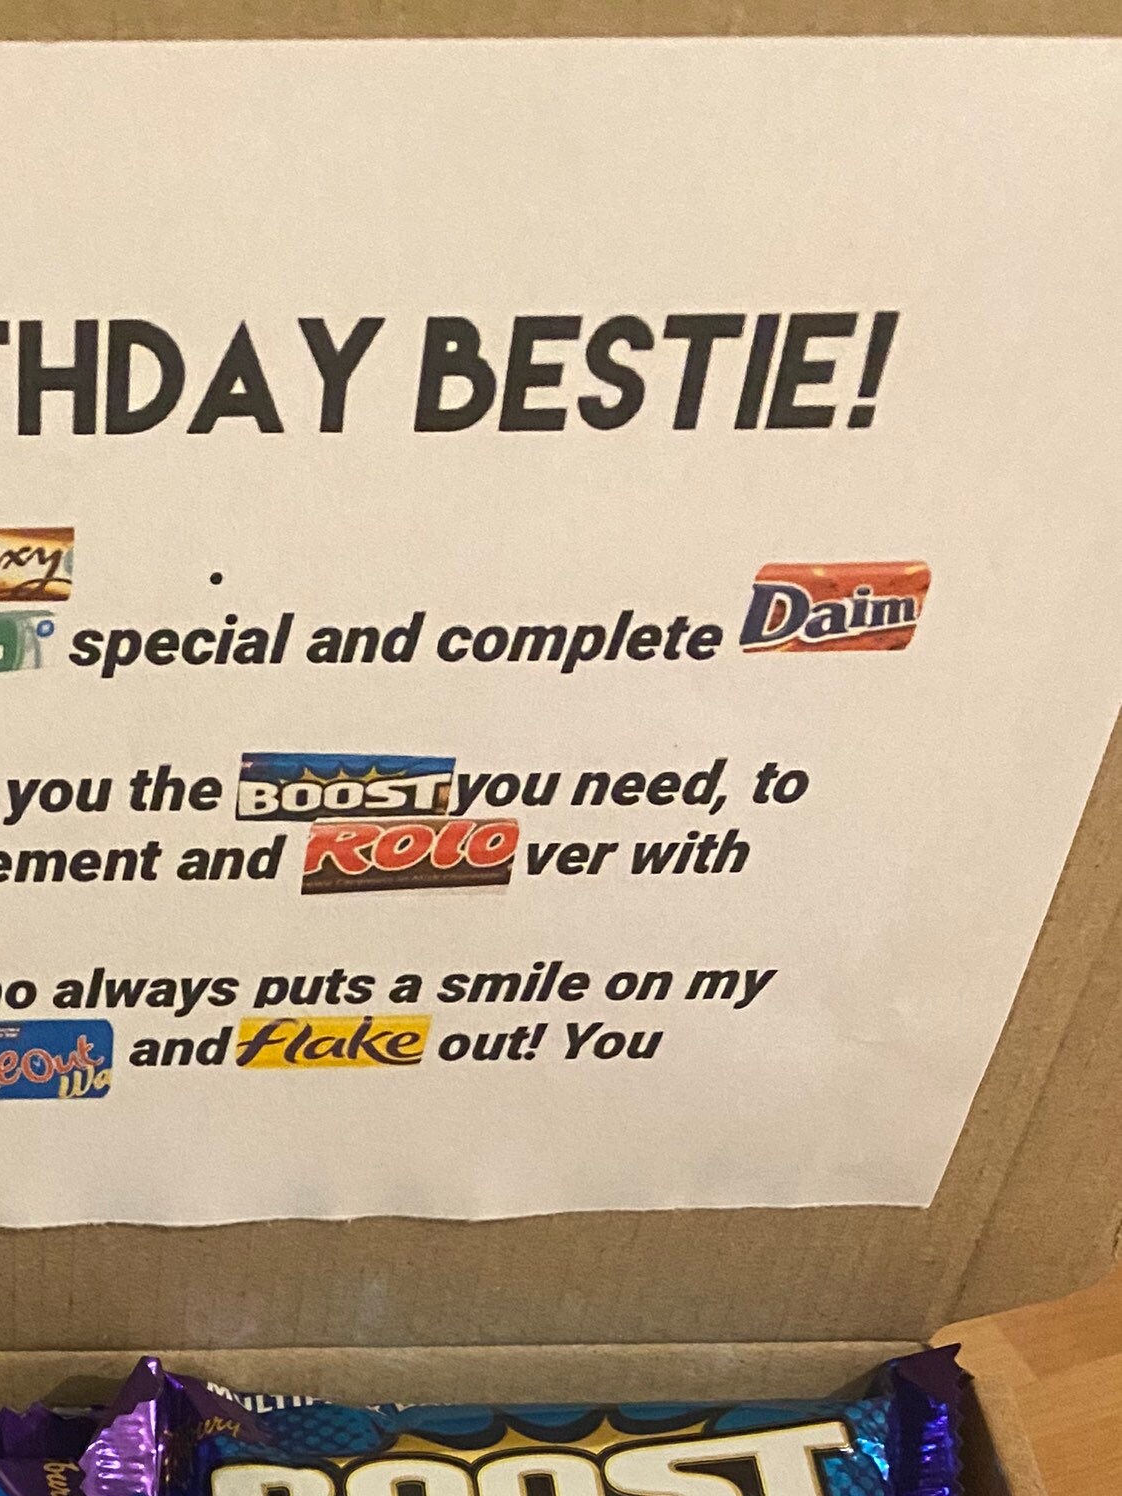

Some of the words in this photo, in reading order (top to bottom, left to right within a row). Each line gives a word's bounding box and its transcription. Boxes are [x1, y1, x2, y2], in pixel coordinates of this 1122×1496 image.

[414, 312, 898, 432] BESTIE!
[69, 613, 286, 678] special
[307, 612, 425, 663] and
[438, 610, 722, 673] complete
[739, 583, 917, 645] Daim
[4, 779, 111, 825] you
[130, 765, 222, 811] the
[237, 773, 451, 816] BOOST
[450, 773, 560, 817] you
[571, 759, 727, 815] need,
[753, 763, 808, 803] to
[177, 835, 286, 880] and
[528, 843, 618, 875] ver
[632, 830, 750, 874] with
[53, 968, 239, 1017] always
[254, 969, 375, 1008] puts
[389, 975, 422, 1003] a
[437, 961, 589, 1002] smile
[606, 972, 672, 1000] on
[685, 970, 777, 1009] my
[129, 1026, 235, 1067] and
[439, 1023, 548, 1061] out!
[565, 1023, 663, 1059] You
